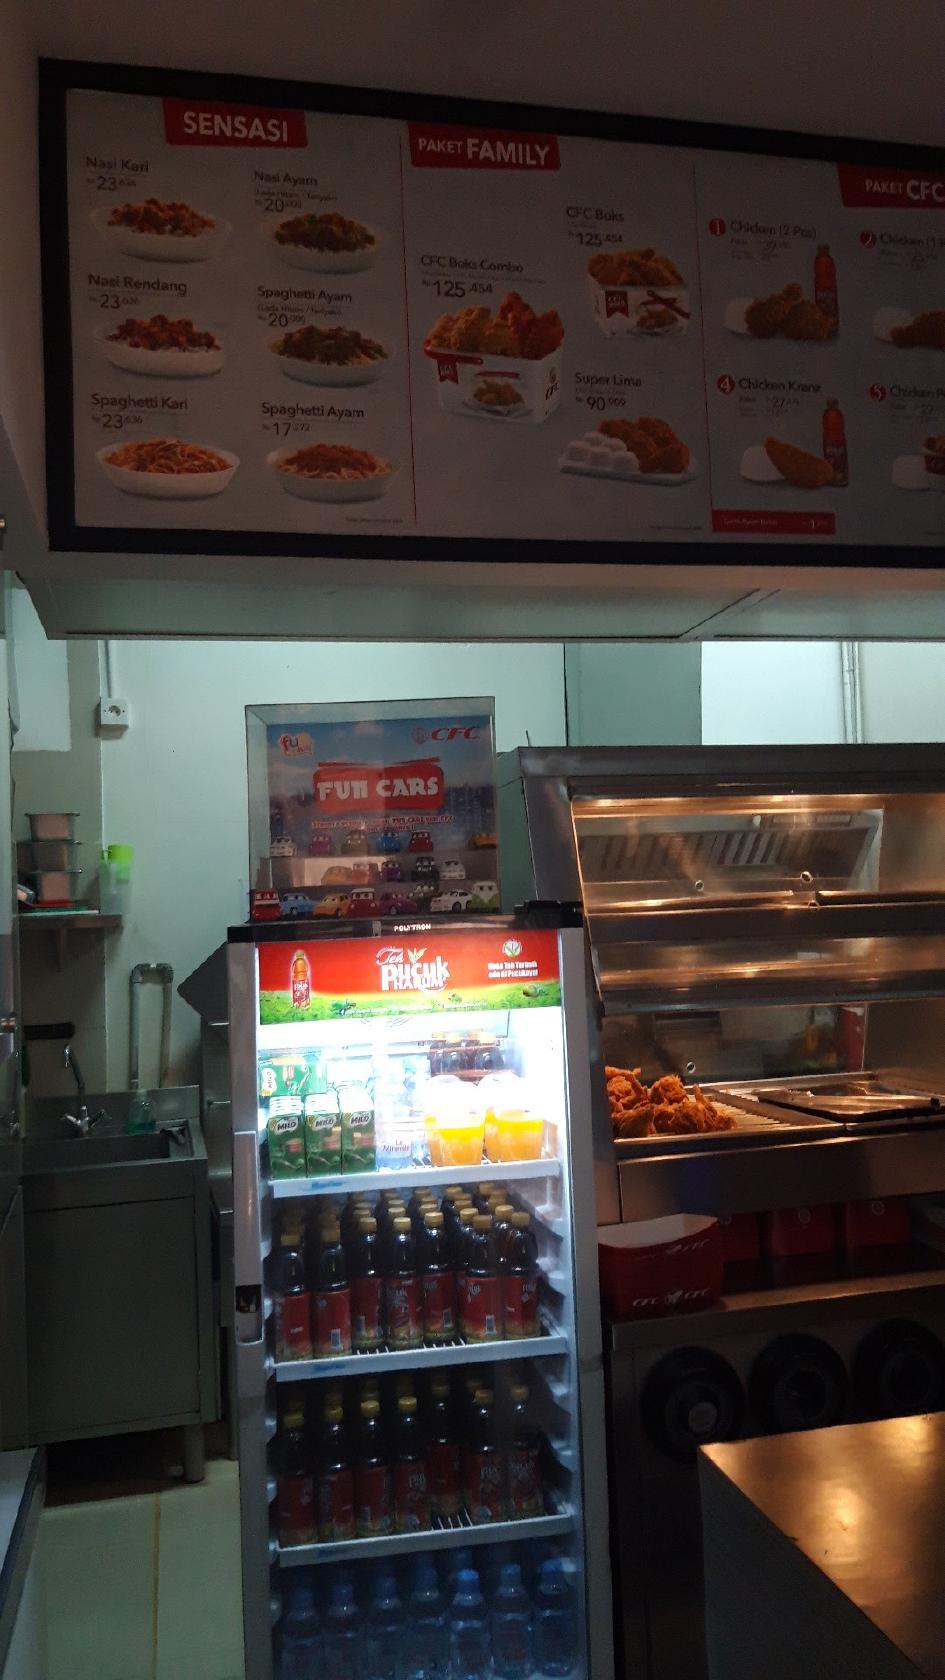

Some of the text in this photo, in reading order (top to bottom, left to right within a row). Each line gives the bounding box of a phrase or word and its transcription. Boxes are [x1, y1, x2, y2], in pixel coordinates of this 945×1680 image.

[183, 110, 288, 143] SENSASI
[418, 137, 550, 166] PAKET FAMILY
[86, 156, 149, 173] Nasi Kari
[254, 170, 318, 187] Nasi Ayam
[865, 178, 945, 201] PAKET CFC
[565, 206, 593, 220] CFC
[730, 220, 776, 236] Chicken
[421, 254, 447, 268] CFC
[480, 259, 524, 274] Combo
[88, 273, 187, 296] Nasi Rendang
[257, 285, 352, 304] Spaghetti Ayam
[575, 373, 610, 388] Super
[738, 378, 785, 392] Chicken
[91, 392, 188, 410] Spaghetti Kari
[262, 402, 365, 423] Spaghetti Ayam
[430, 726, 481, 742] CFC
[316, 777, 439, 801] FUN CARS
[394, 923, 432, 933] POLYTRON
[376, 946, 404, 965] Teh
[277, 1121, 297, 1131] MILO
[314, 1118, 335, 1128] MILO
[350, 1114, 370, 1125] MILO
